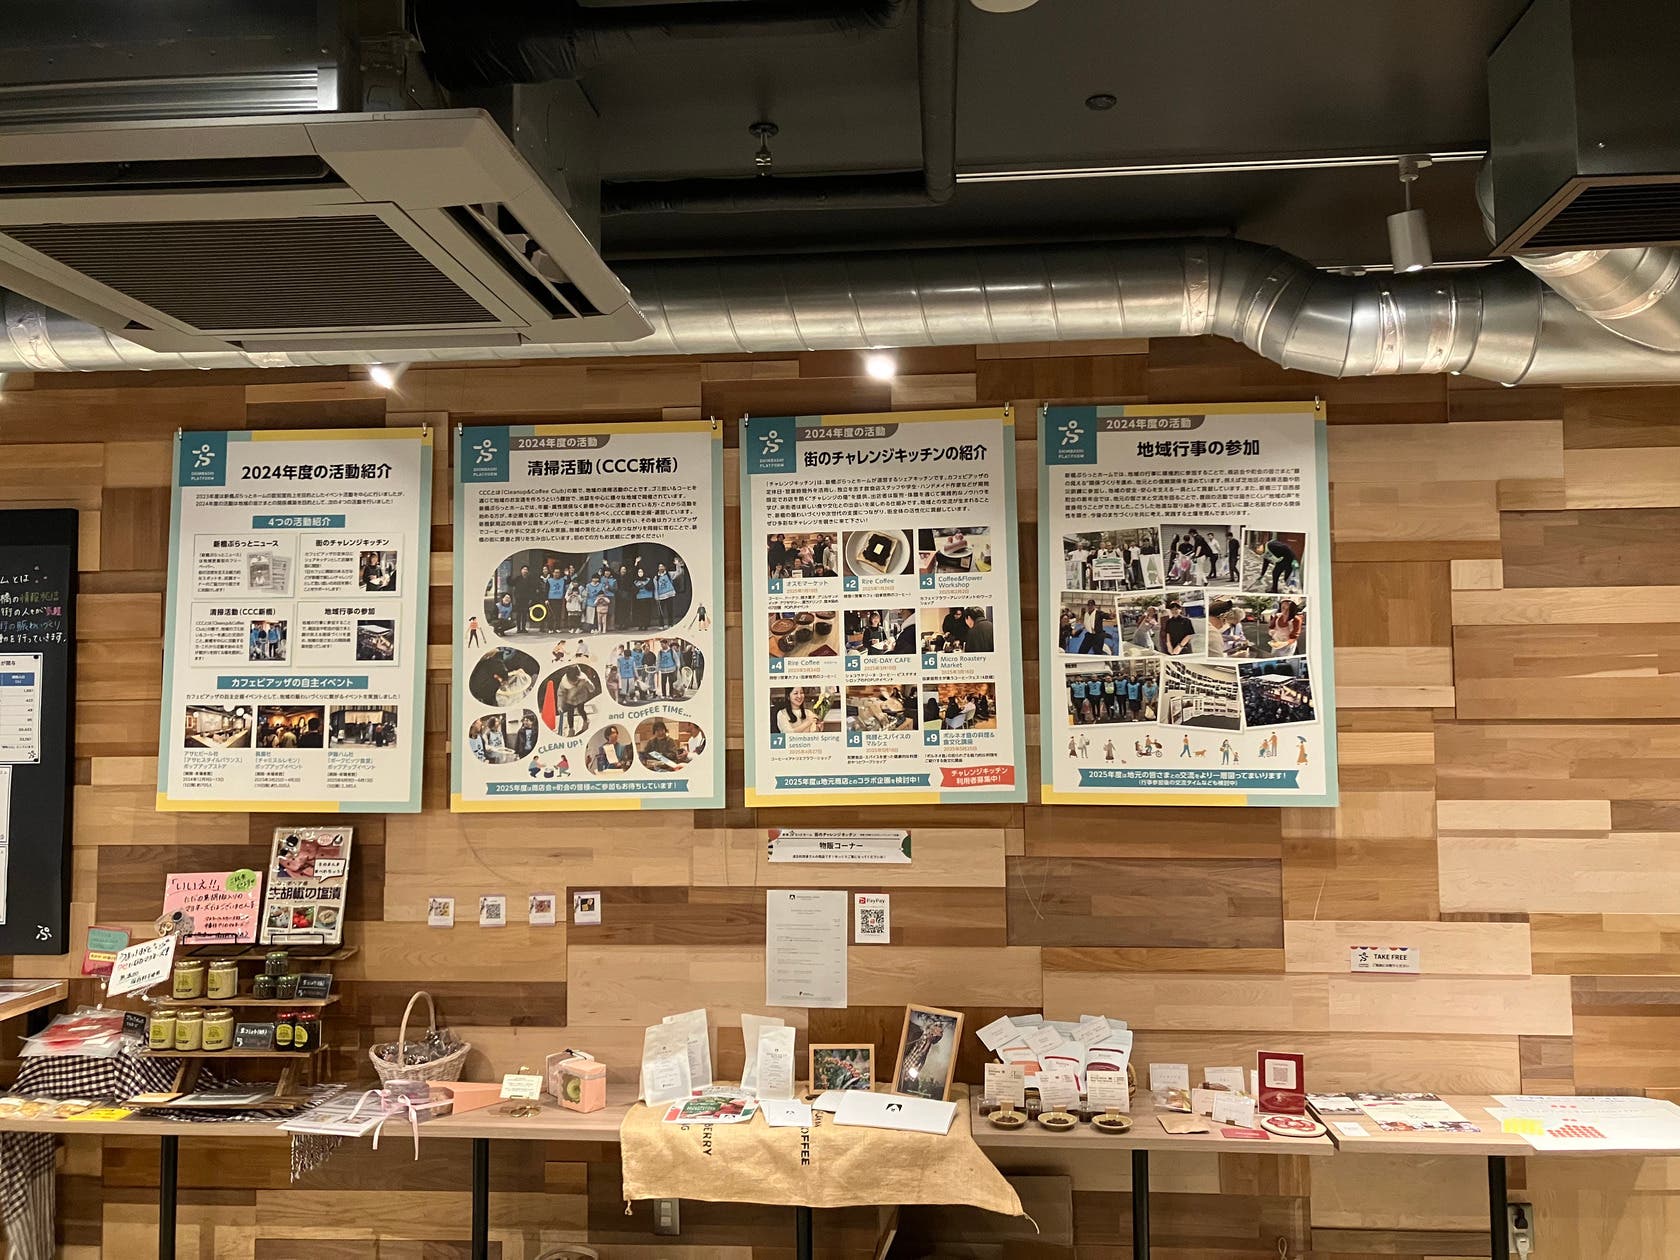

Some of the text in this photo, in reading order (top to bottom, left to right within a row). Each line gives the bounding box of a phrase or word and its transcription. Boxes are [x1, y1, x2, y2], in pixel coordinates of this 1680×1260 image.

[1106, 419, 1191, 430] 2024年度の活動
[804, 426, 886, 439] 2024年度の活動
[518, 436, 598, 448] 2024年度の活動
[1137, 439, 1260, 458] 地域行事の参加
[804, 444, 987, 467] 街のチャレンジキッチンの紹介
[241, 463, 392, 480] 2024年度の活動紹介
[528, 457, 678, 476] 清掃活動(CCC新橋)
[268, 517, 332, 527] 4つの活動紹介
[608, 712, 624, 720] and
[628, 705, 660, 719] COFFEE
[538, 739, 583, 755] CLEAN UP!
